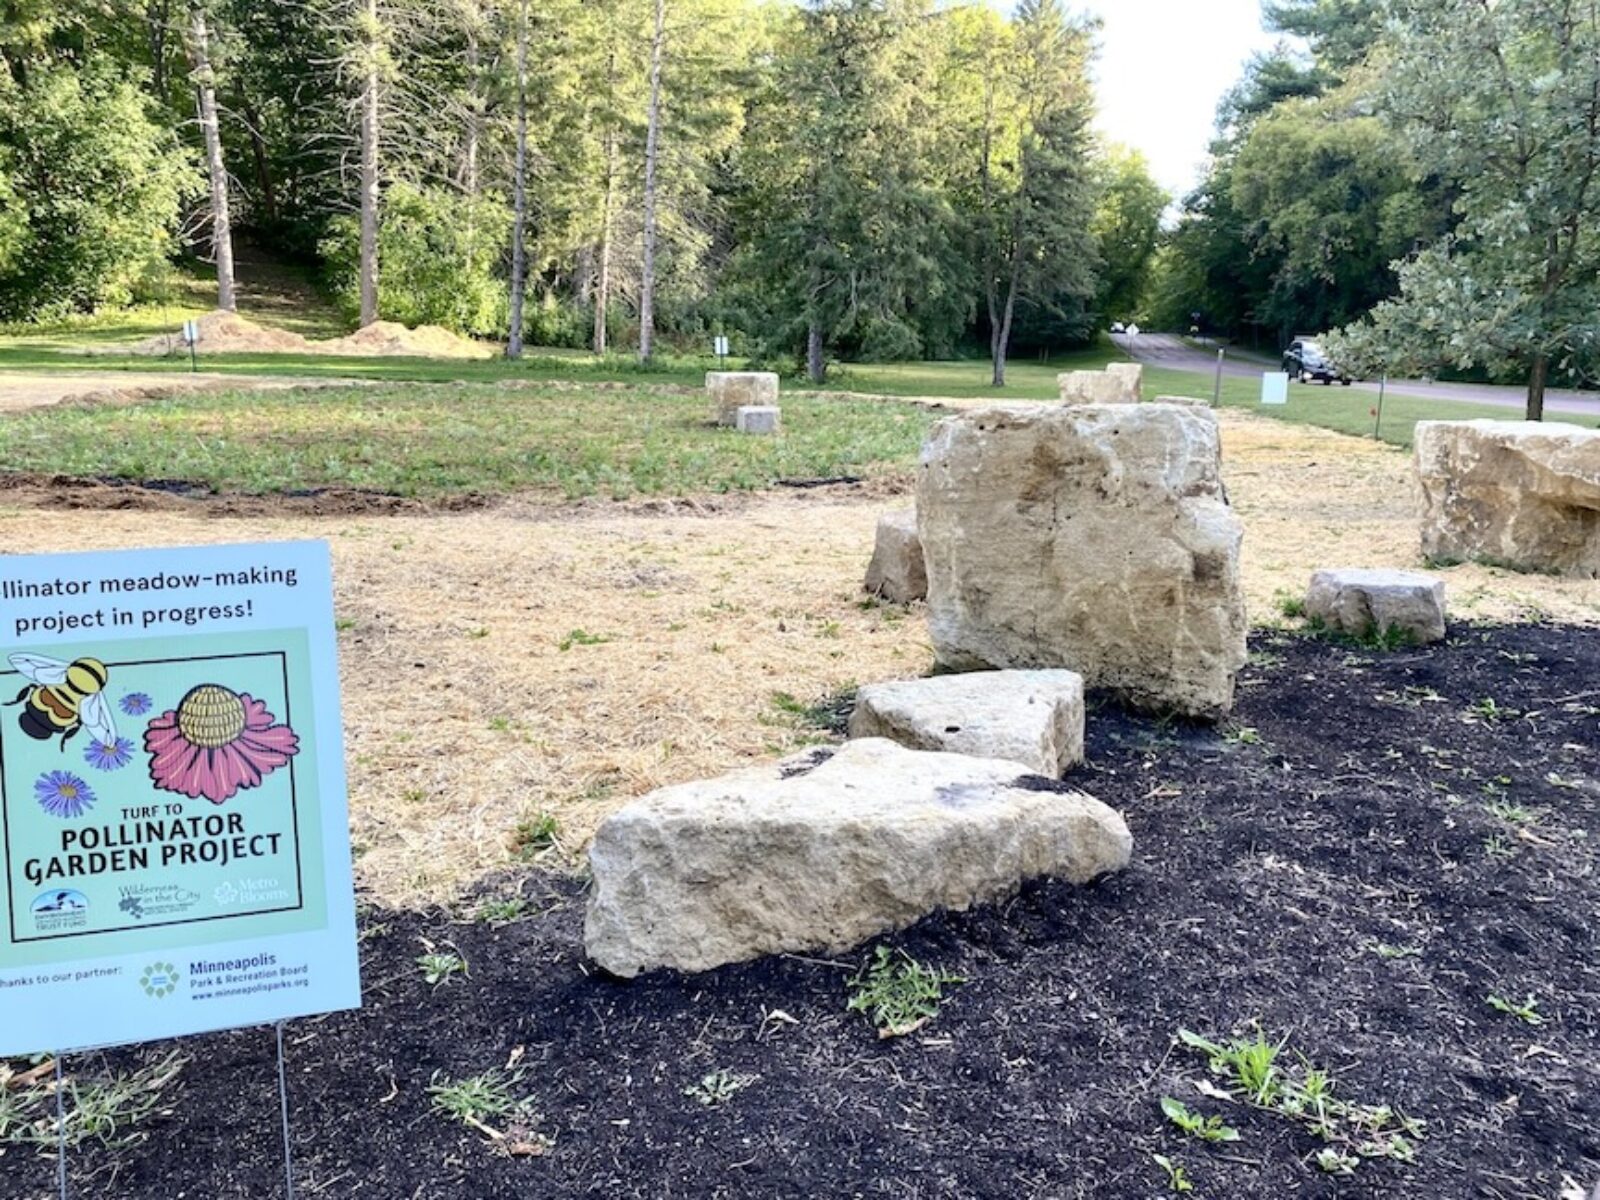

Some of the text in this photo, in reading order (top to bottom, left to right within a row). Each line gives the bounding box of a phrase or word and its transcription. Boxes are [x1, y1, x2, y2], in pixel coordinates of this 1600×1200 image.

[100, 566, 298, 592] meadow-making
[15, 599, 253, 636] project in progress!
[121, 803, 183, 820] TURF TO
[61, 812, 245, 851] POLLINATOR
[24, 832, 282, 887] GARDEN PROJECT
[118, 883, 178, 897] Wilderness
[155, 893, 172, 903] the
[174, 888, 200, 903] City
[239, 878, 279, 891] Metro
[240, 888, 289, 904] Blooms
[190, 952, 277, 975] Minneapolis
[36, 974, 49, 985] to
[51, 971, 71, 983] our
[190, 964, 308, 989] Park & Recreation Board
[192, 979, 308, 1001] www.minneapolisparks.org
